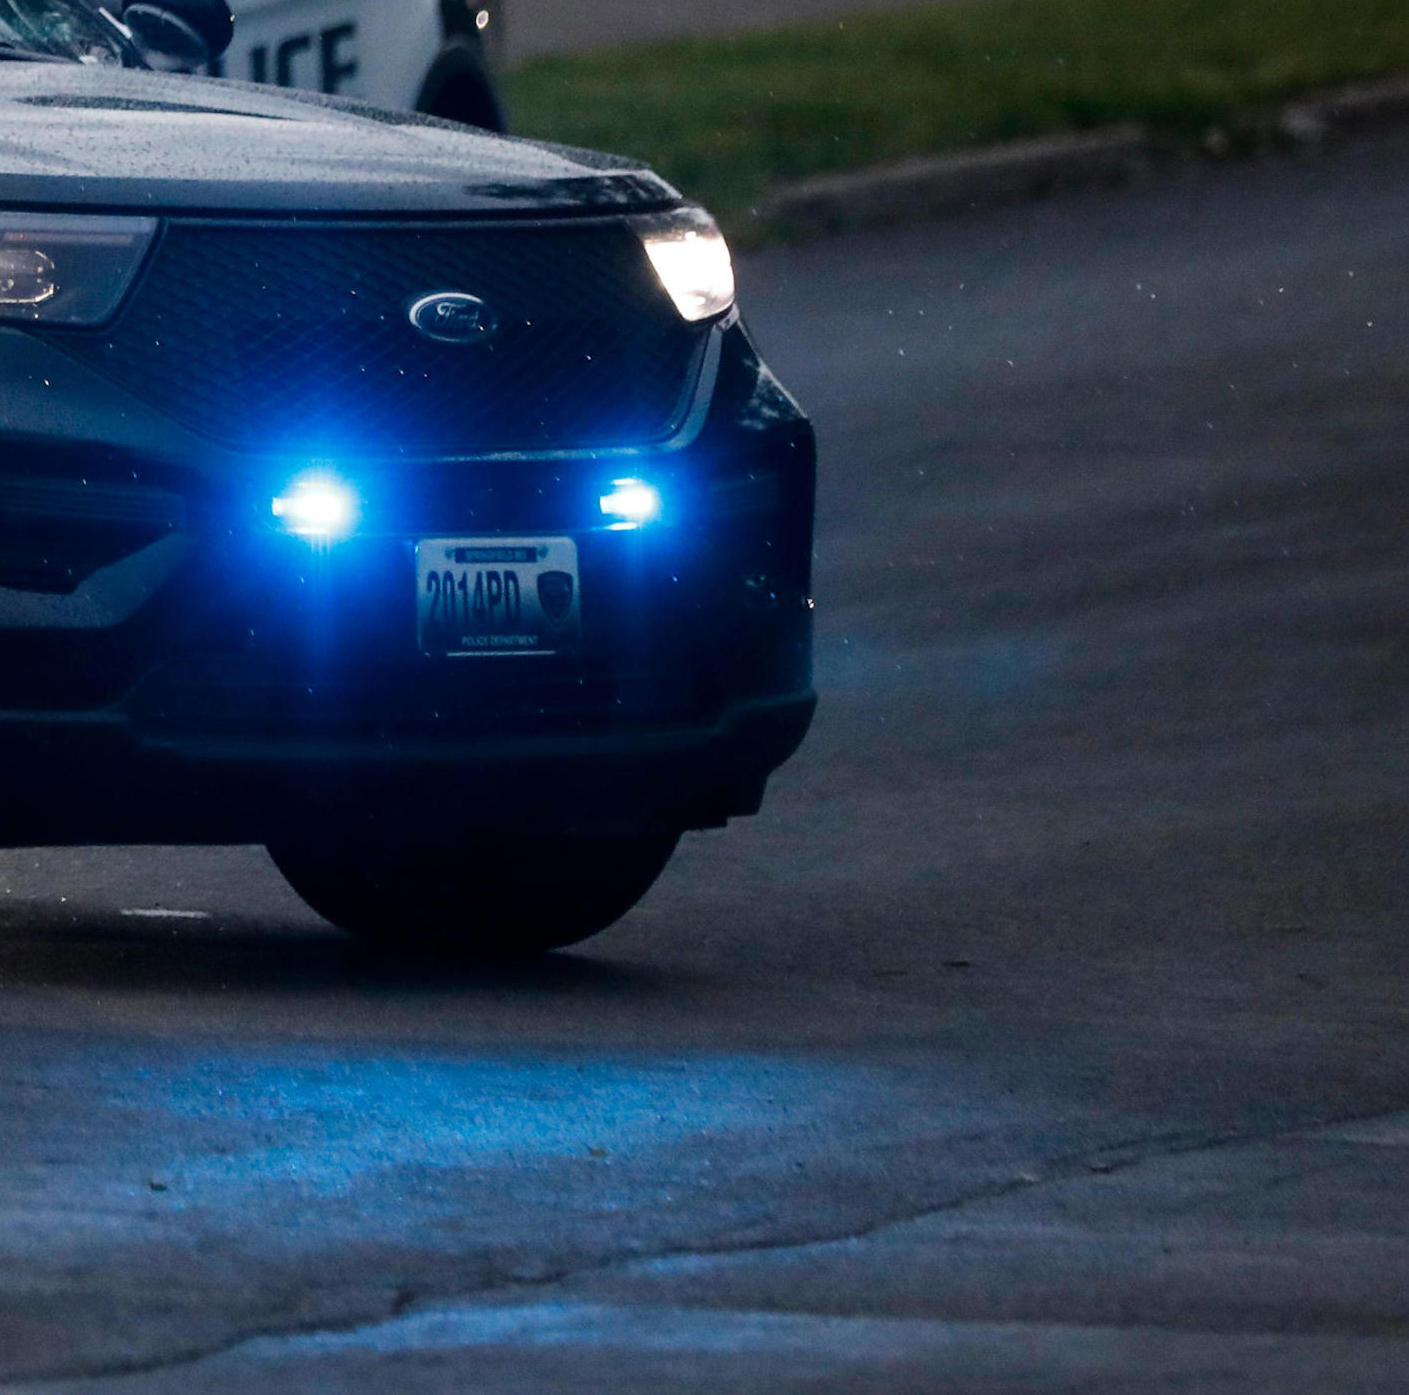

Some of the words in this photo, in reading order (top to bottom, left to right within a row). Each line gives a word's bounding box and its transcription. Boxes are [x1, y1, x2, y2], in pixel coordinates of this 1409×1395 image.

[435, 301, 480, 327] Ford
[426, 569, 521, 626] 2014PD
[461, 635, 488, 646] POLICE
[490, 635, 538, 646] DEPARTMENT
